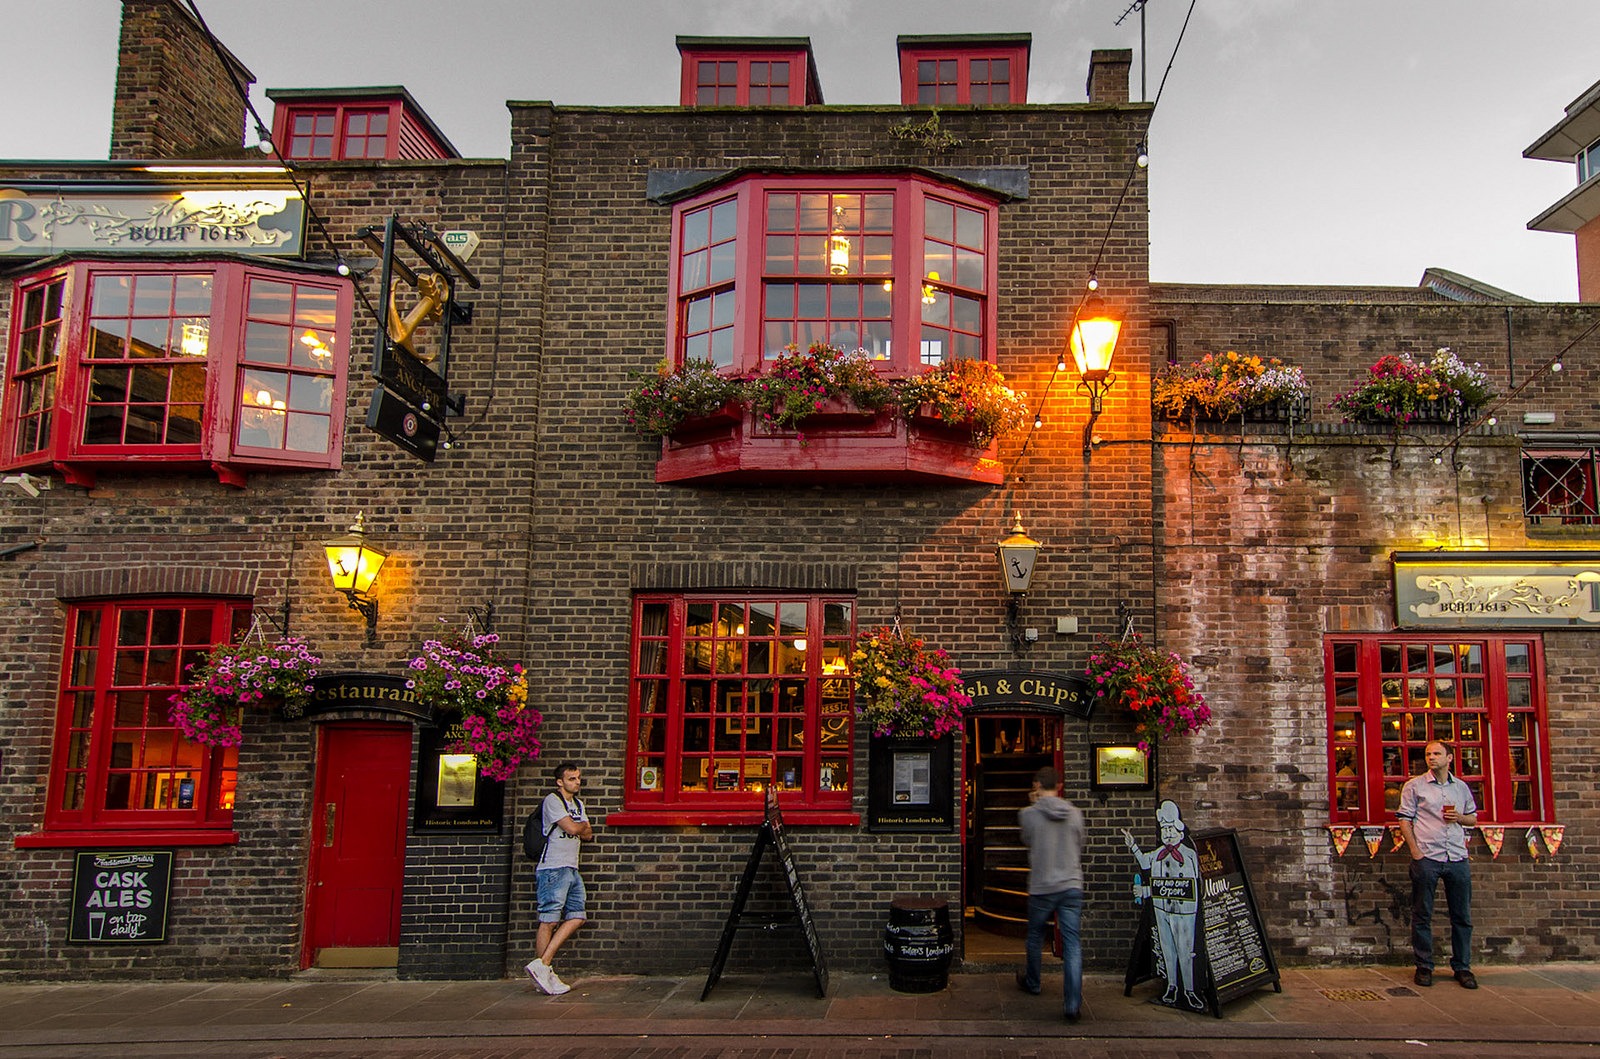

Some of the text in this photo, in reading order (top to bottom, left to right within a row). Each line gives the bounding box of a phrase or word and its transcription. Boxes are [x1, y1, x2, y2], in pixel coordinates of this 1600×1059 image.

[0, 200, 37, 242] R
[129, 226, 246, 241] BUILT 1615
[1440, 602, 1507, 612] BUILT 1615
[315, 684, 424, 705] estauran
[953, 679, 1079, 705] ish & Chips
[95, 872, 148, 888] CASK
[1160, 886, 1185, 897] Open
[1203, 878, 1230, 900] Menu
[85, 890, 152, 908] ALES
[109, 911, 147, 926] on tap
[110, 923, 146, 938] daily
